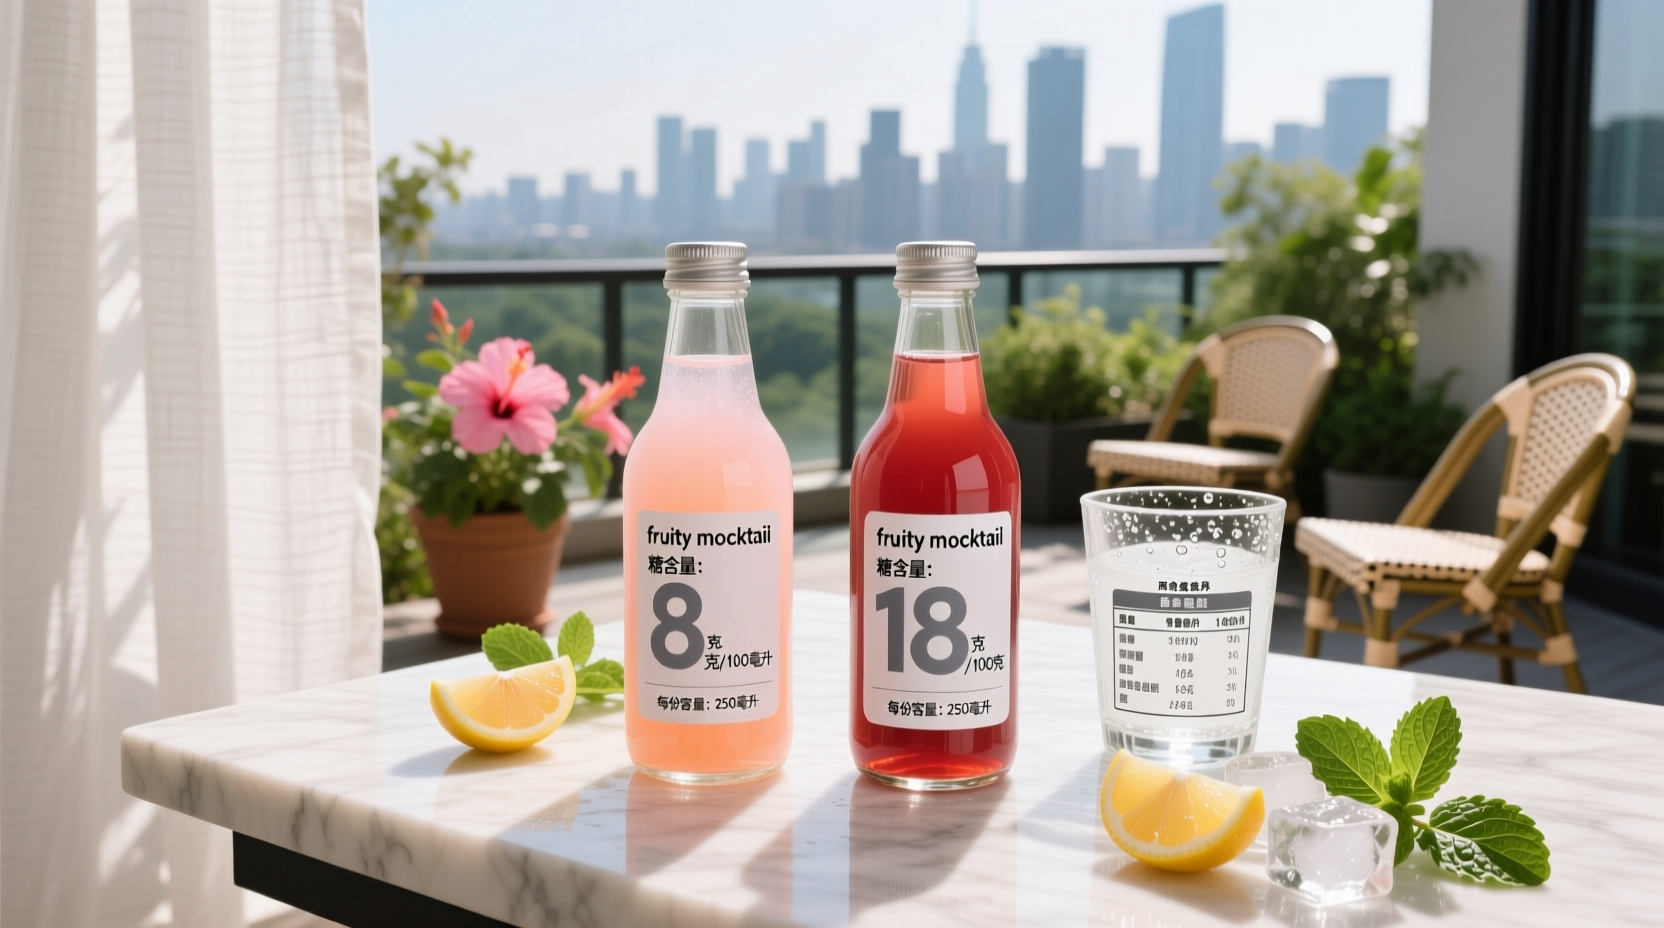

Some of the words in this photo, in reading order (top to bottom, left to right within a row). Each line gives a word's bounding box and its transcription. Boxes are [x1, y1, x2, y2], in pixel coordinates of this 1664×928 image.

[647, 525, 692, 551] fruity
[697, 525, 771, 546] mocktail
[876, 527, 925, 553] fruity
[930, 526, 1003, 549] mocktail
[651, 582, 705, 670] 8
[876, 586, 969, 676] 18
